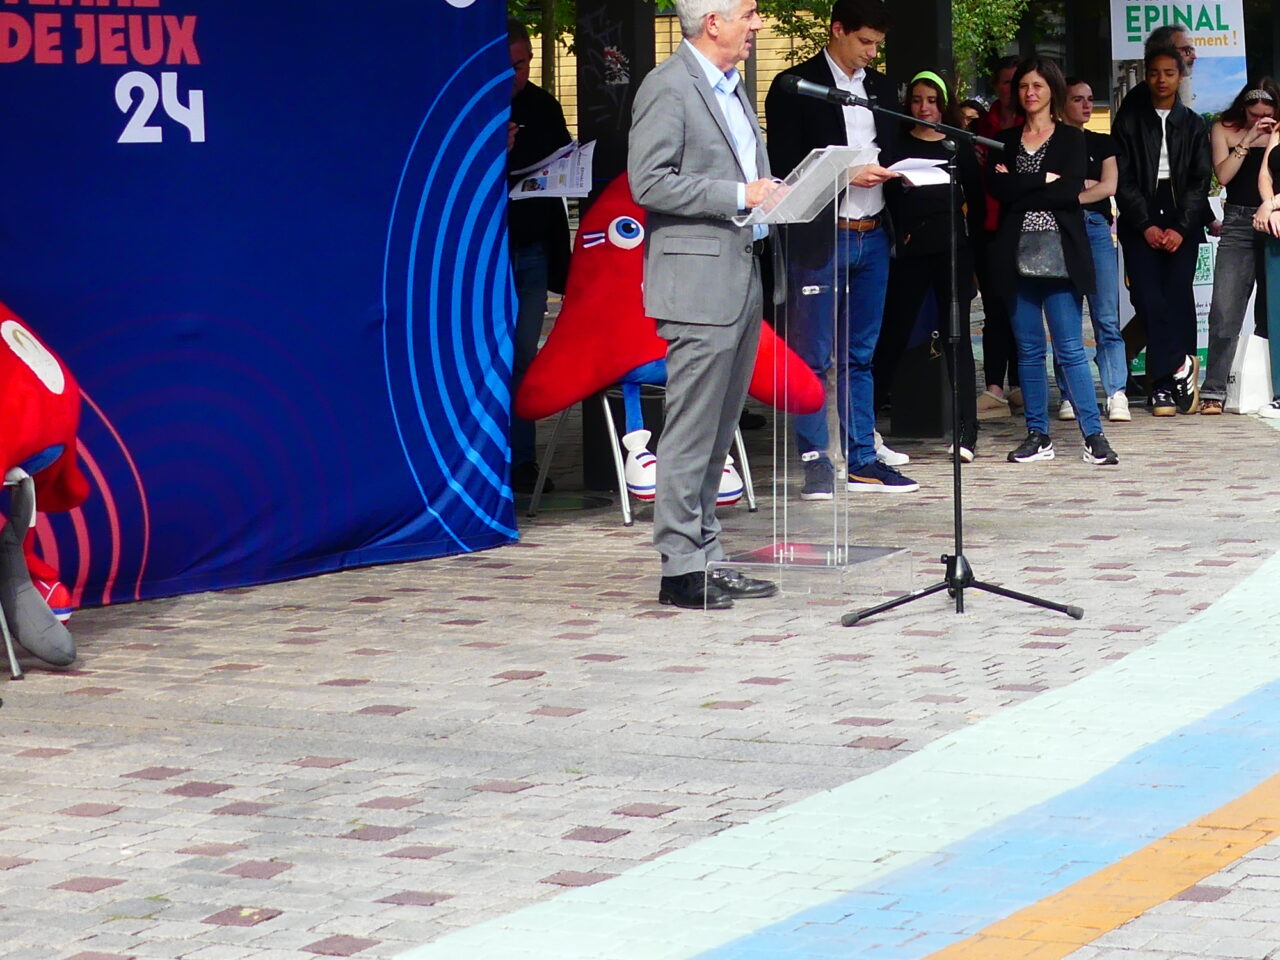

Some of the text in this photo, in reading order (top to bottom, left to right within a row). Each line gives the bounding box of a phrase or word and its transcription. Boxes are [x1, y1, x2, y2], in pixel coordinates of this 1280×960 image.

[0, 12, 201, 66] DE JEUX
[1126, 4, 1229, 33] EPINAL
[115, 71, 206, 144] 24
